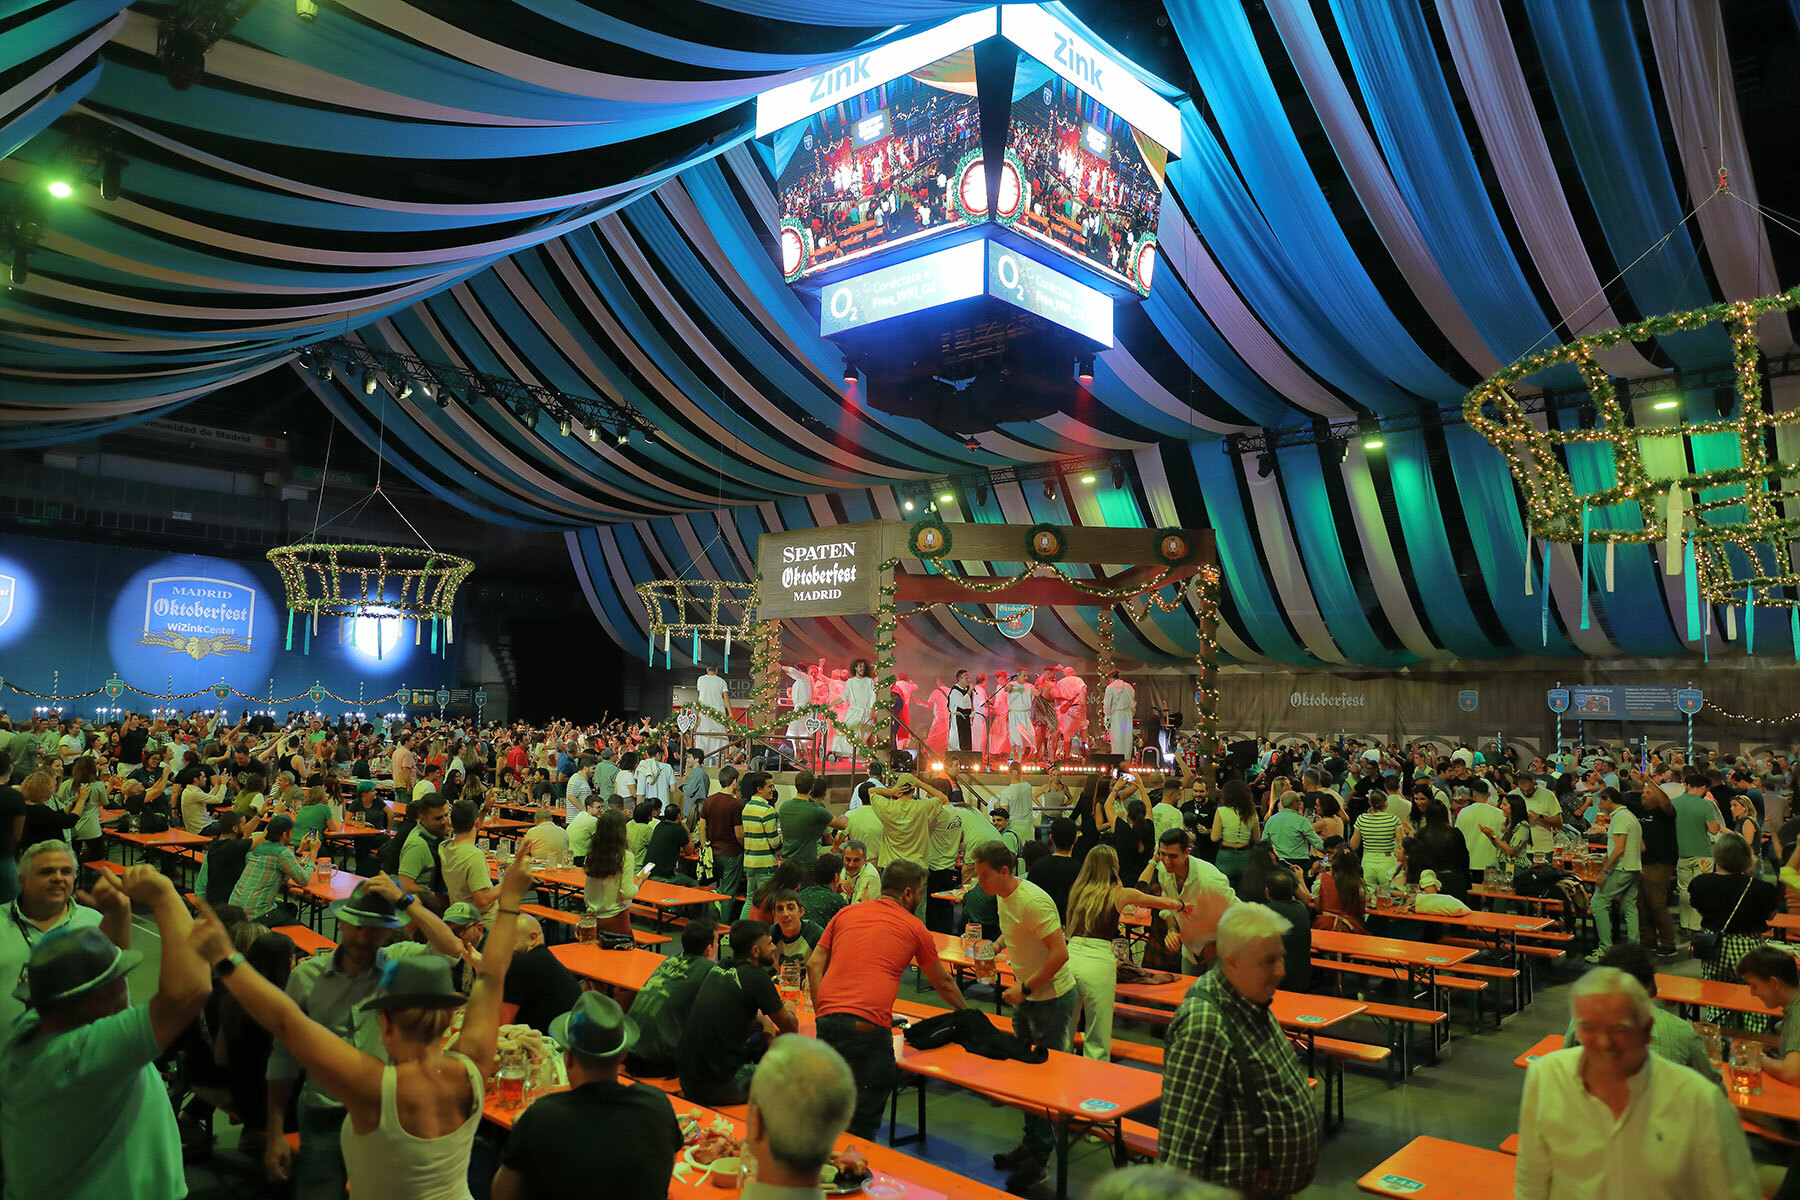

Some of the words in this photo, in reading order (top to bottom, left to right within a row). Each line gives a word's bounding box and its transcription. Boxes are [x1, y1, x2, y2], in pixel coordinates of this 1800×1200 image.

[1053, 31, 1104, 93] Zink
[809, 55, 871, 103] Zink
[143, 419, 197, 435] omunidad
[200, 427, 213, 437] de
[216, 430, 251, 444] Madrid
[783, 541, 856, 564] SPATEN
[781, 562, 857, 589] Oktoberfest
[172, 586, 233, 599] MADRID
[793, 588, 842, 602] MADRID
[153, 597, 248, 622] Oktoberfest
[167, 622, 236, 635] WiZinkCenter
[729, 680, 751, 690] LID
[730, 690, 747, 698] XIT
[1290, 691, 1366, 709] Oktoberfest
